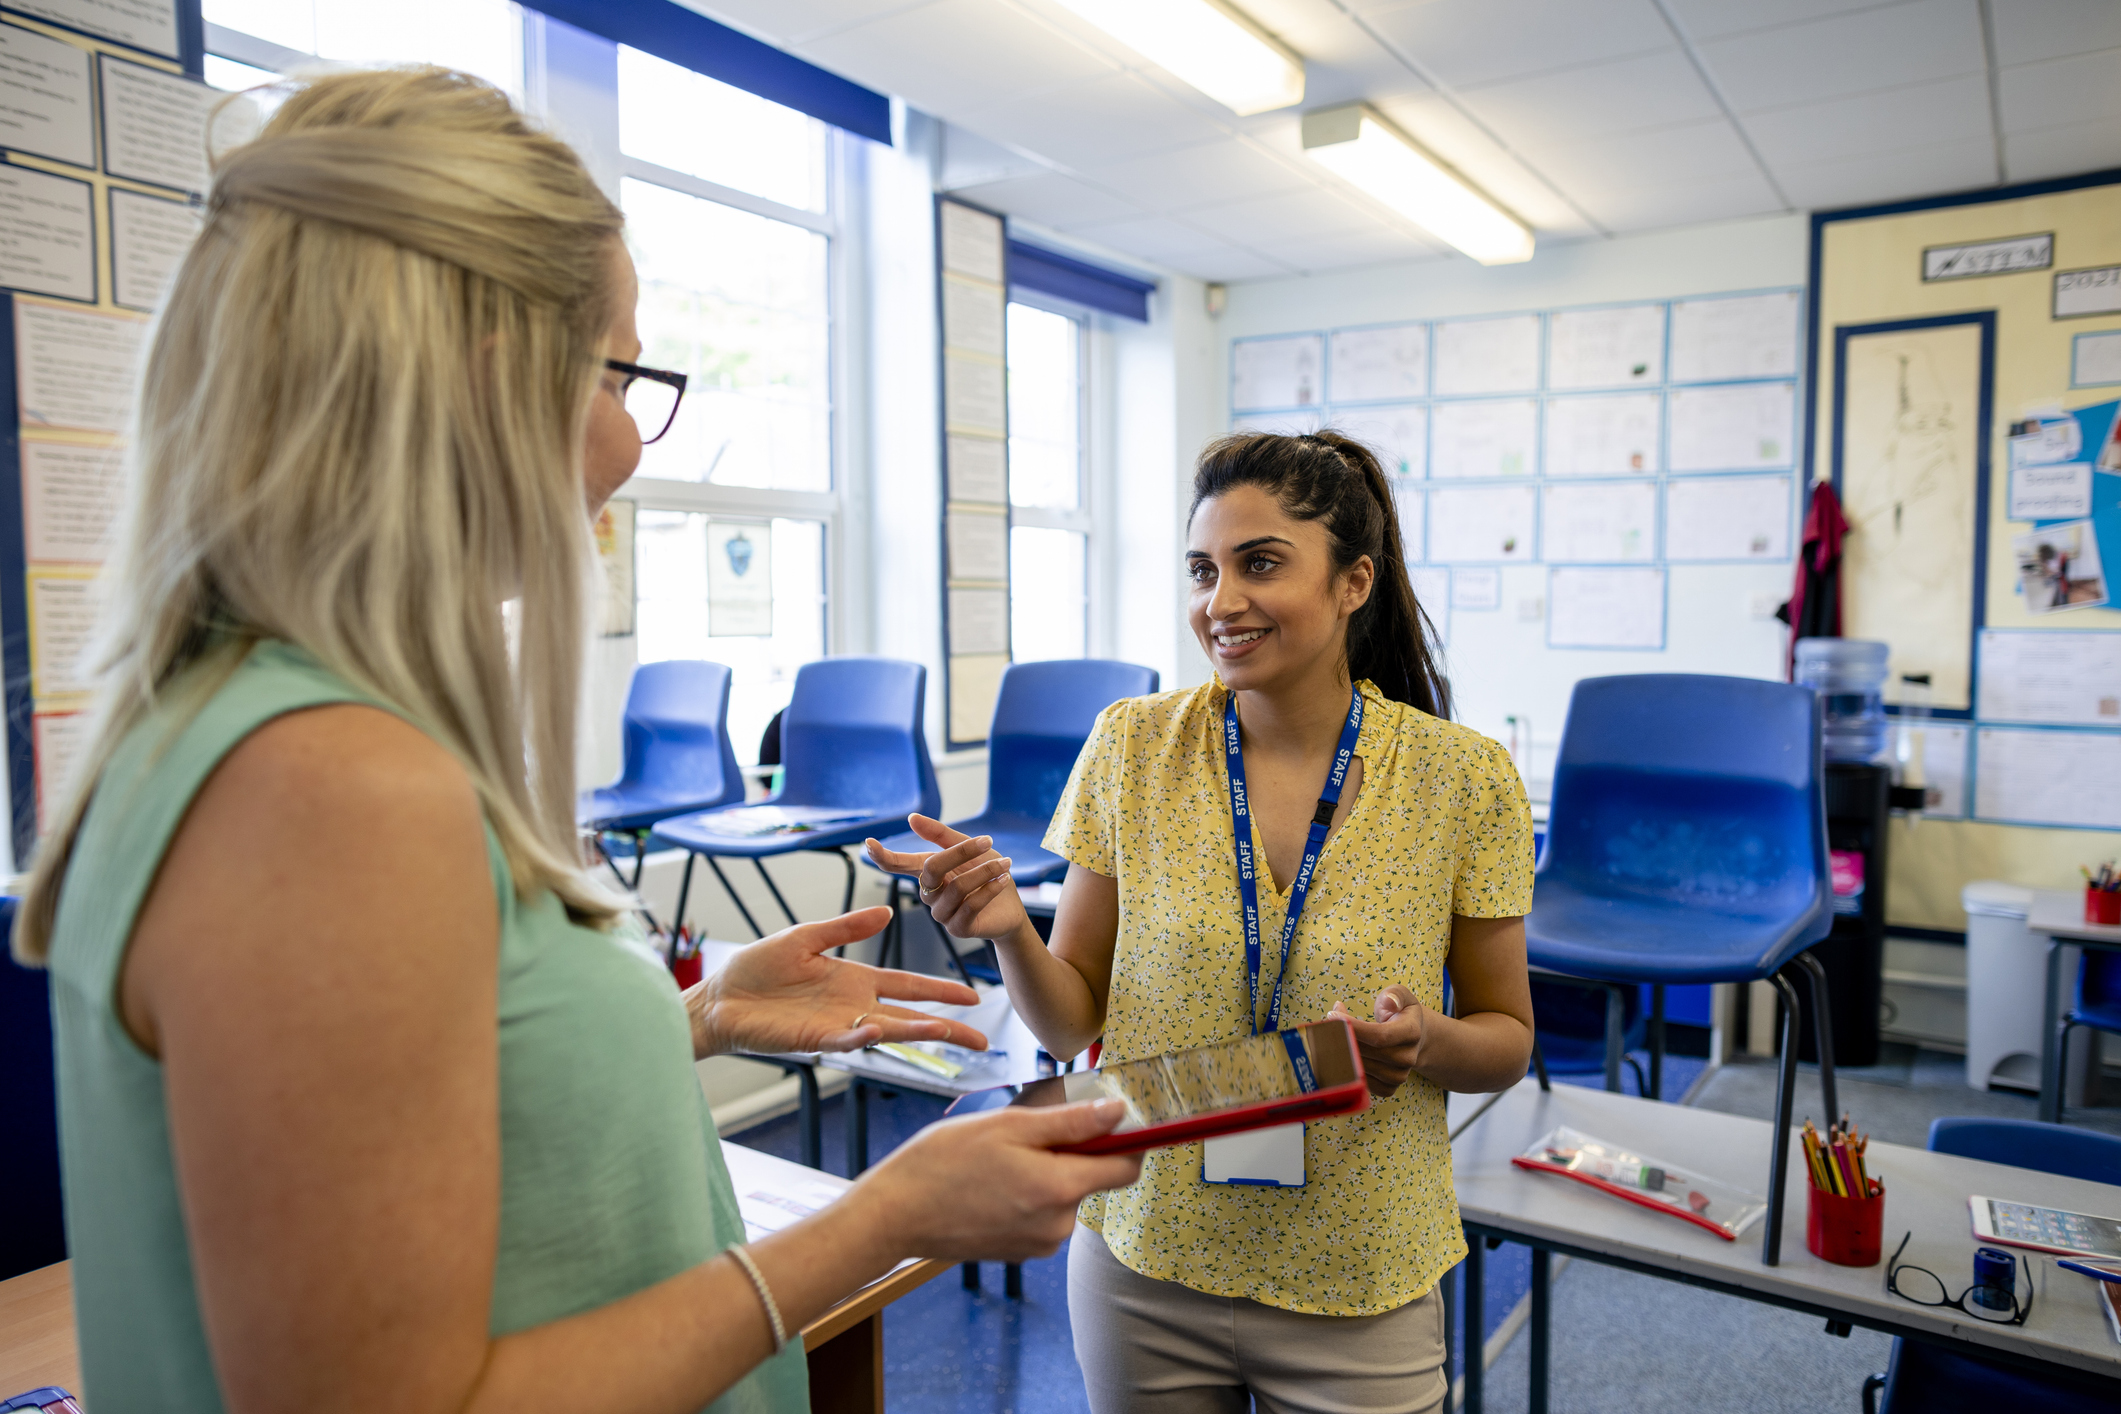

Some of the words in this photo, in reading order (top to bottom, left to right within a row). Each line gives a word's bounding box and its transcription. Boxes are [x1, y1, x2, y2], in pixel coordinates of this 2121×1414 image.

[1350, 693, 1362, 729] STAFF
[1226, 719, 1239, 755] STAFF
[1331, 748, 1350, 787] STAFF
[1233, 778, 1247, 816] STAFF
[1240, 840, 1252, 880] STAFF
[1296, 853, 1315, 893] STAFF
[1246, 905, 1258, 945] STAFF
[1281, 916, 1295, 957] STAFF
[1271, 983, 1282, 1022] STAFF
